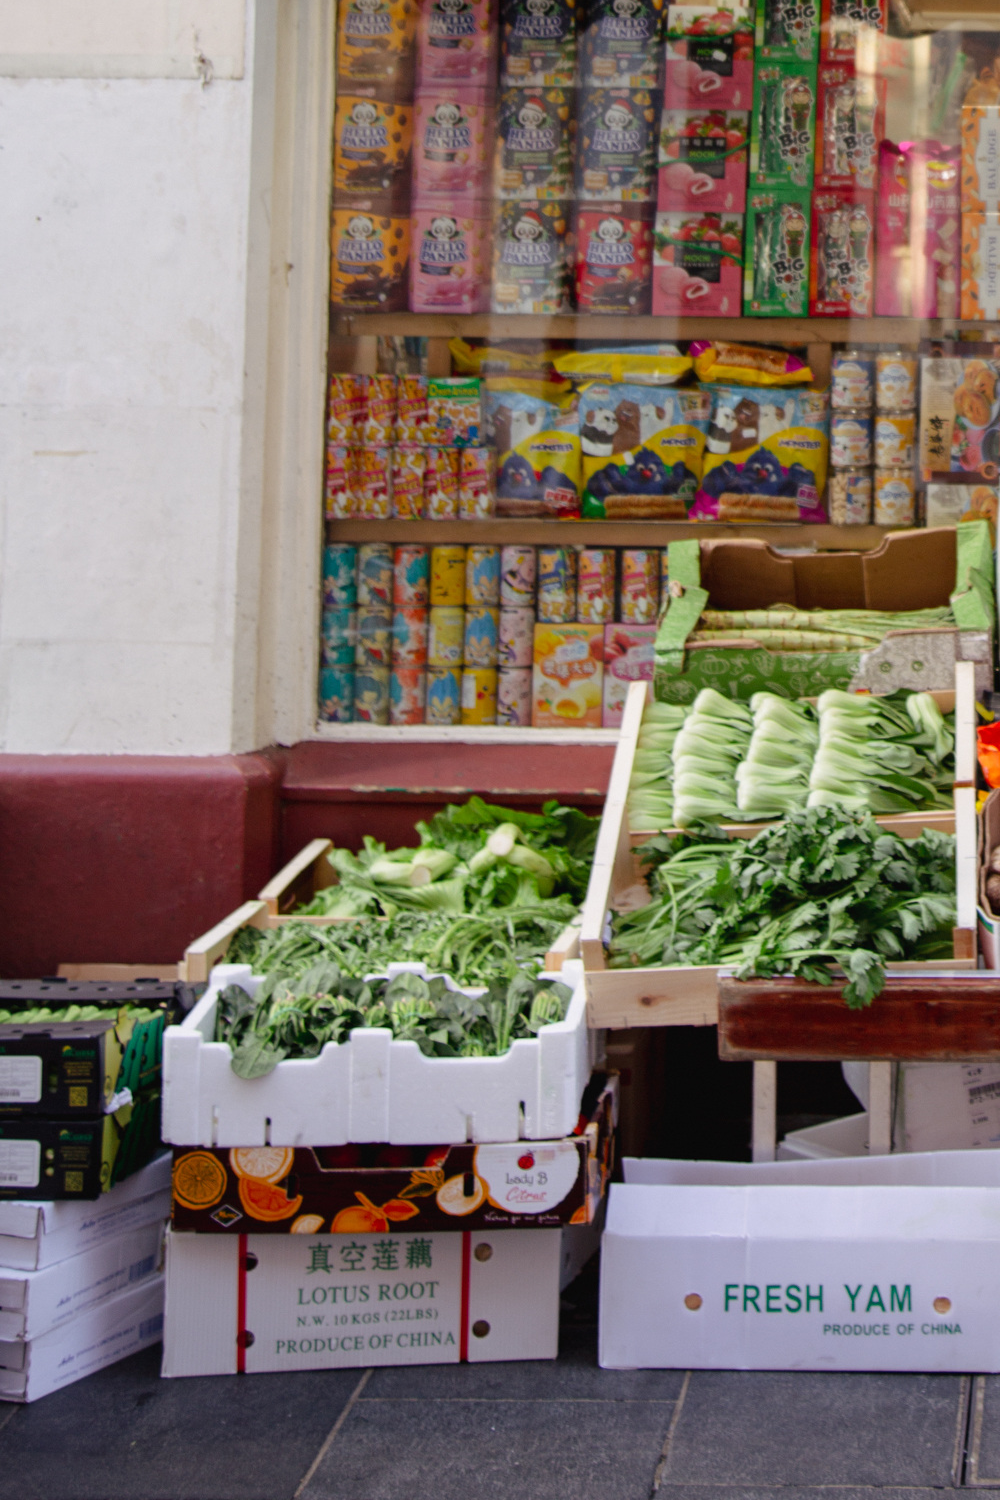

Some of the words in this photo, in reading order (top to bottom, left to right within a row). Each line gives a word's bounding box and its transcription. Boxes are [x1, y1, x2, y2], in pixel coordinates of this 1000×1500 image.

[422, 241, 467, 252] HELLO
[588, 242, 634, 253] HELLO
[420, 250, 469, 263] PANDA
[586, 251, 635, 265] PANDA
[505, 1172, 534, 1186] Lady
[538, 1173, 548, 1186] B
[306, 1237, 434, 1275] 真空莲藕
[297, 1284, 370, 1306] LOTUS
[378, 1281, 440, 1302] ROOT
[724, 1284, 824, 1313] FRESH
[843, 1284, 912, 1313] YAM
[297, 1314, 329, 1328] N.W.
[334, 1314, 348, 1326] 10
[352, 1312, 380, 1325] KGS
[384, 1308, 439, 1324] (22LBS)
[823, 1323, 890, 1336] PRODUCE
[896, 1324, 914, 1335] OF
[921, 1323, 963, 1335] CHINA
[275, 1336, 365, 1355] PRODUCE
[369, 1334, 394, 1350] OF
[396, 1331, 456, 1348] CHINA
